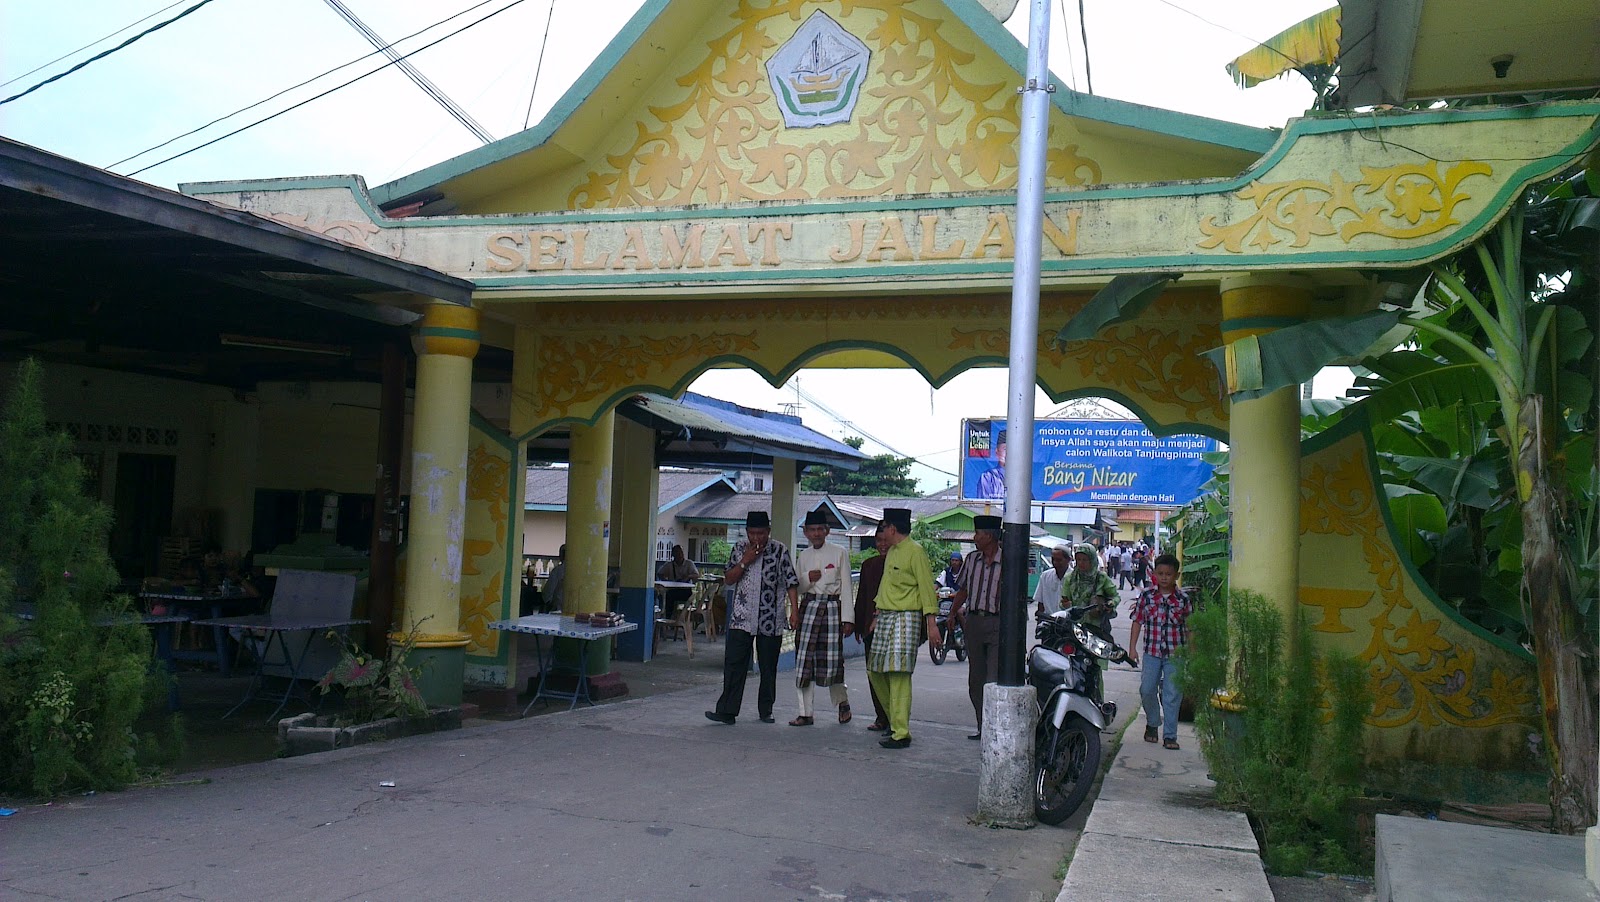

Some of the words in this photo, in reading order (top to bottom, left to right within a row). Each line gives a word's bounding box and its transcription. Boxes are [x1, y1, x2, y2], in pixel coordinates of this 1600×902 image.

[485, 222, 793, 273] SELAMAT
[827, 208, 1083, 263] JALAN
[970, 430, 990, 438] Untuk
[1039, 428, 1072, 436] mohon
[1073, 427, 1093, 436] do'a
[1095, 428, 1119, 436] restu
[1121, 427, 1138, 436] dan
[1041, 438, 1066, 447] Insya
[1067, 438, 1091, 446] Allah
[1093, 440, 1115, 449] saya
[1117, 439, 1140, 447] akan
[1142, 439, 1165, 449] maju
[1168, 440, 1206, 449] menjadi
[1066, 449, 1091, 457] calon
[1093, 449, 1133, 457] Walikota
[1054, 461, 1095, 470] Bersama
[1043, 466, 1085, 492] Bang
[1091, 466, 1138, 487] Nizar
[1090, 492, 1128, 502] Memimpin
[1129, 493, 1157, 503] dengan
[1158, 493, 1175, 502] Hati
